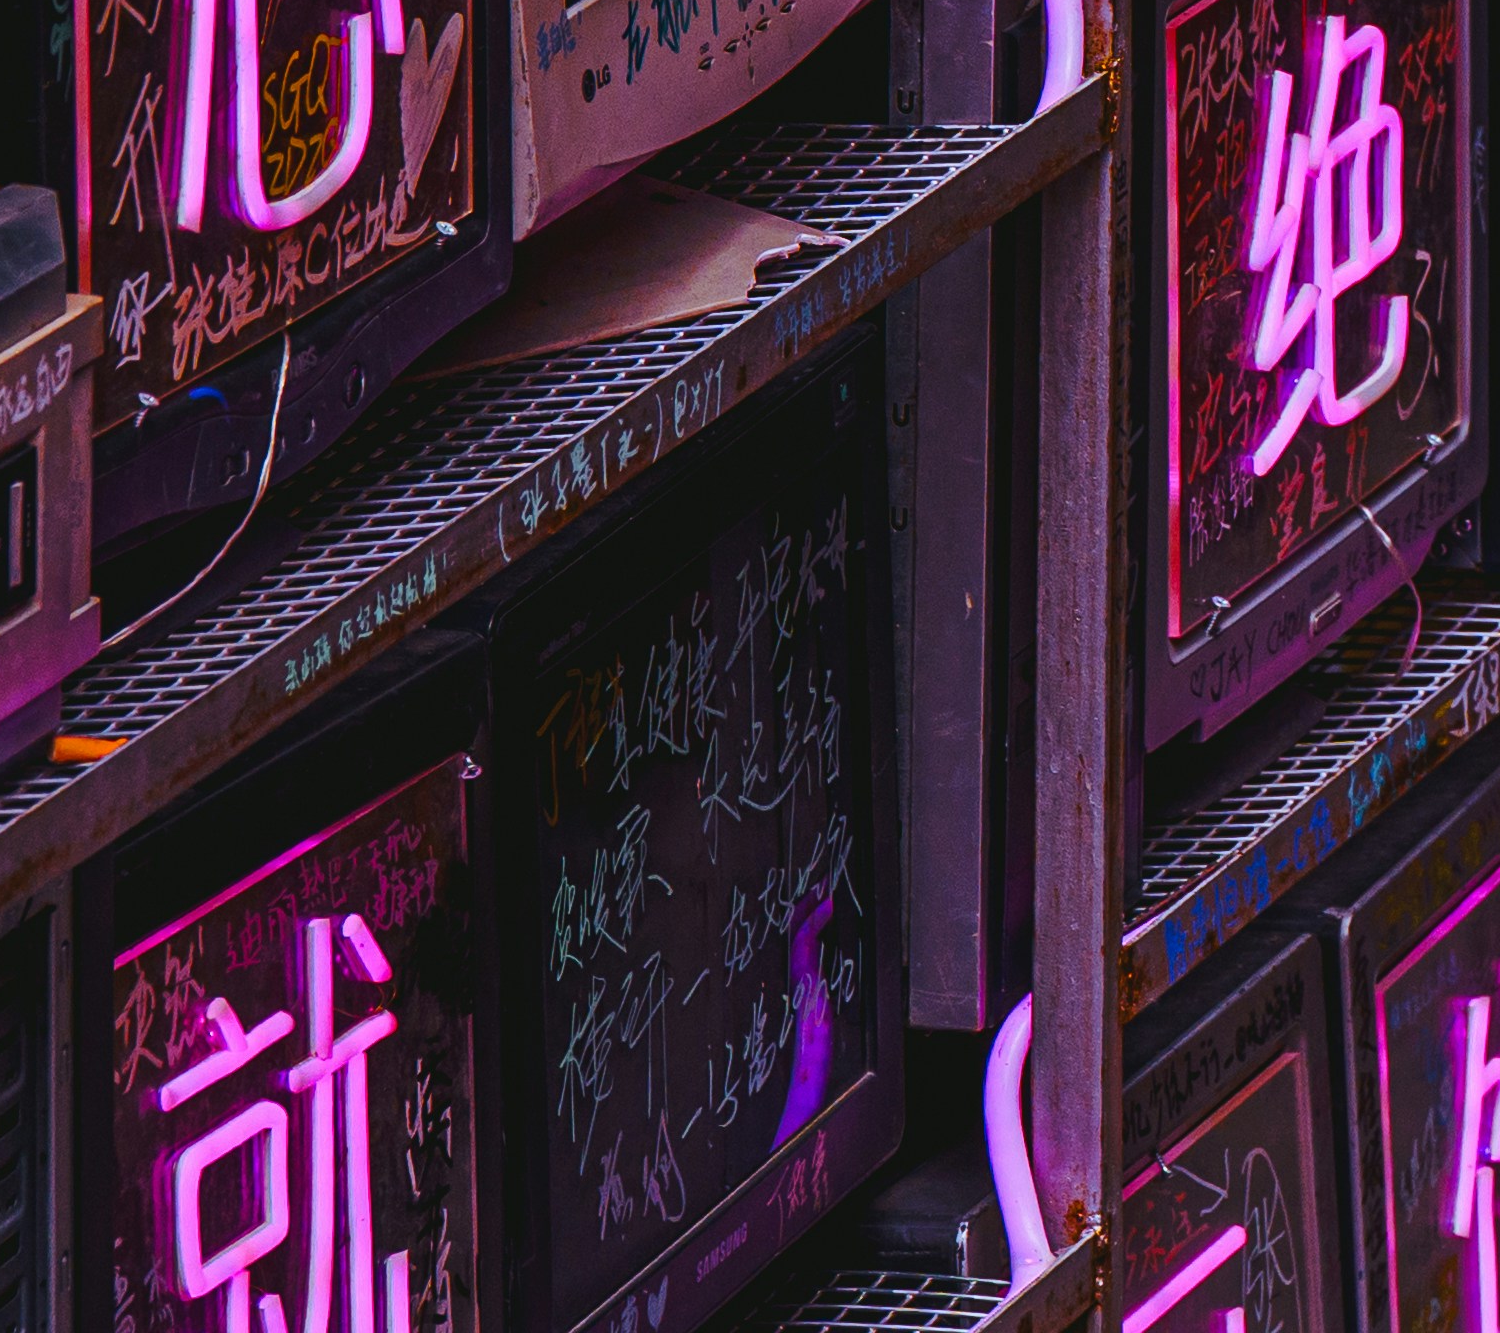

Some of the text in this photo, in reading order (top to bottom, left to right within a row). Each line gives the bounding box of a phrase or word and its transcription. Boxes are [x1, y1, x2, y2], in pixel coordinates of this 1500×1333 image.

[1245, 13, 1410, 478] 绝
[1209, 629, 1258, 703] JAY
[157, 911, 413, 1333] 就
[694, 1220, 749, 1284] SAMSUNG
